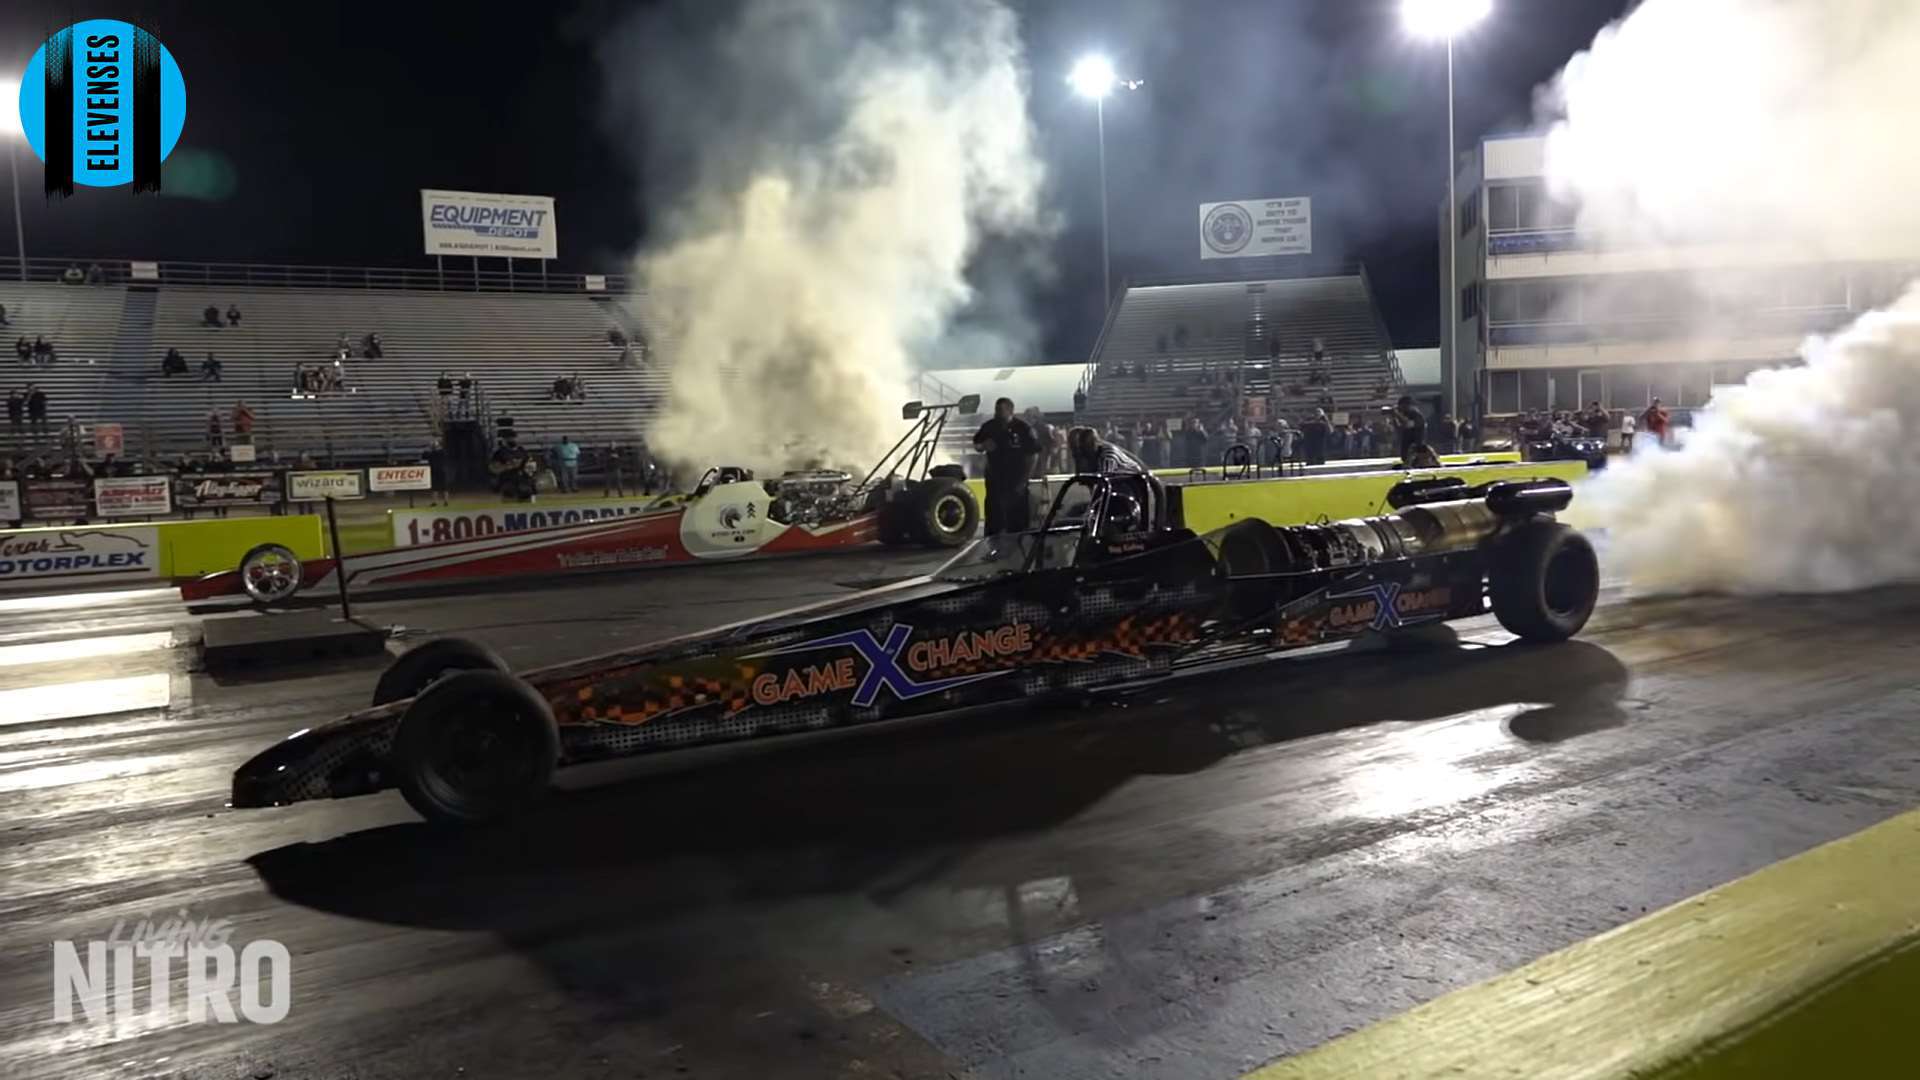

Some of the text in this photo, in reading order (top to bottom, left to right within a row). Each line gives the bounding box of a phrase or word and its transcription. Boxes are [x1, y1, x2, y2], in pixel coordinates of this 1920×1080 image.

[431, 204, 547, 227] EQUIPMENT
[488, 227, 528, 237] DEPOT
[377, 470, 425, 480] ENTECH
[0, 551, 145, 574] OTORPLEX
[752, 658, 857, 704] GAME
[907, 623, 1033, 672] CHANGE
